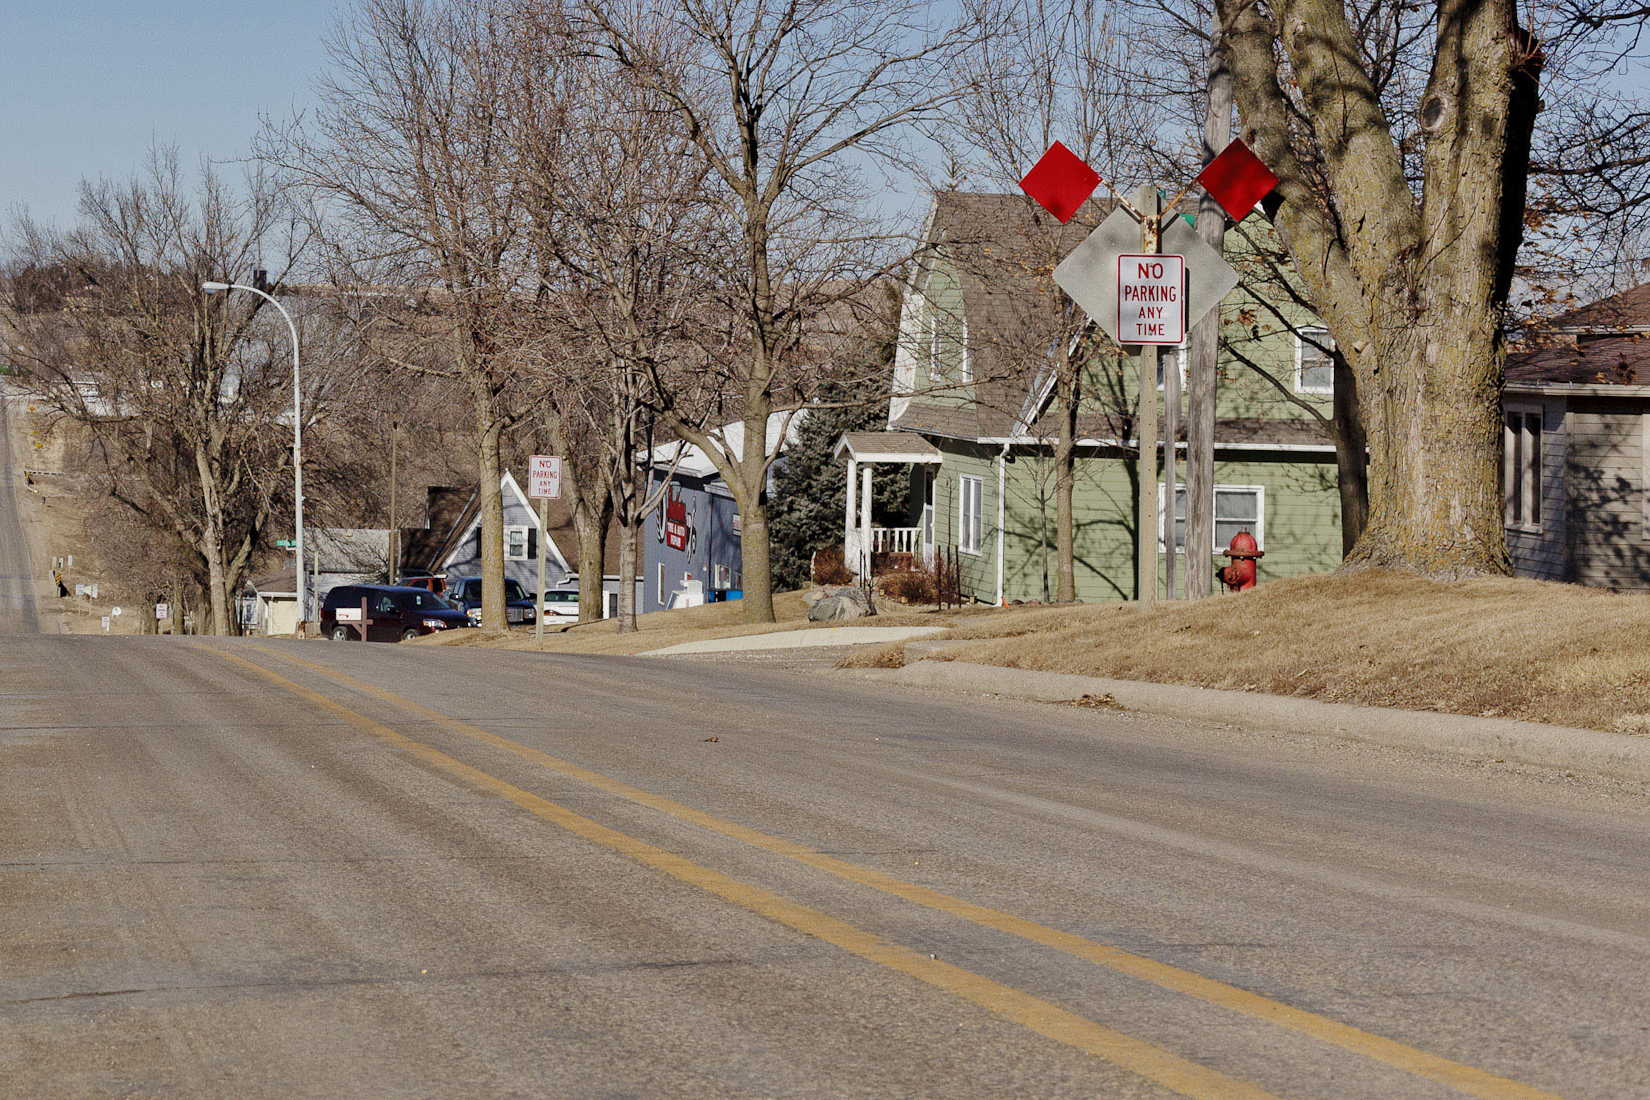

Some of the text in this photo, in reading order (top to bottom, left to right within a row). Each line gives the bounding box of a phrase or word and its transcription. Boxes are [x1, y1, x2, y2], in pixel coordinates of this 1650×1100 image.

[1138, 263, 1163, 279] NO
[1125, 285, 1176, 302] PARKING
[1138, 306, 1163, 319] ANY
[1136, 323, 1165, 336] TIME
[539, 460, 551, 468] NO
[532, 470, 557, 479] PARKING
